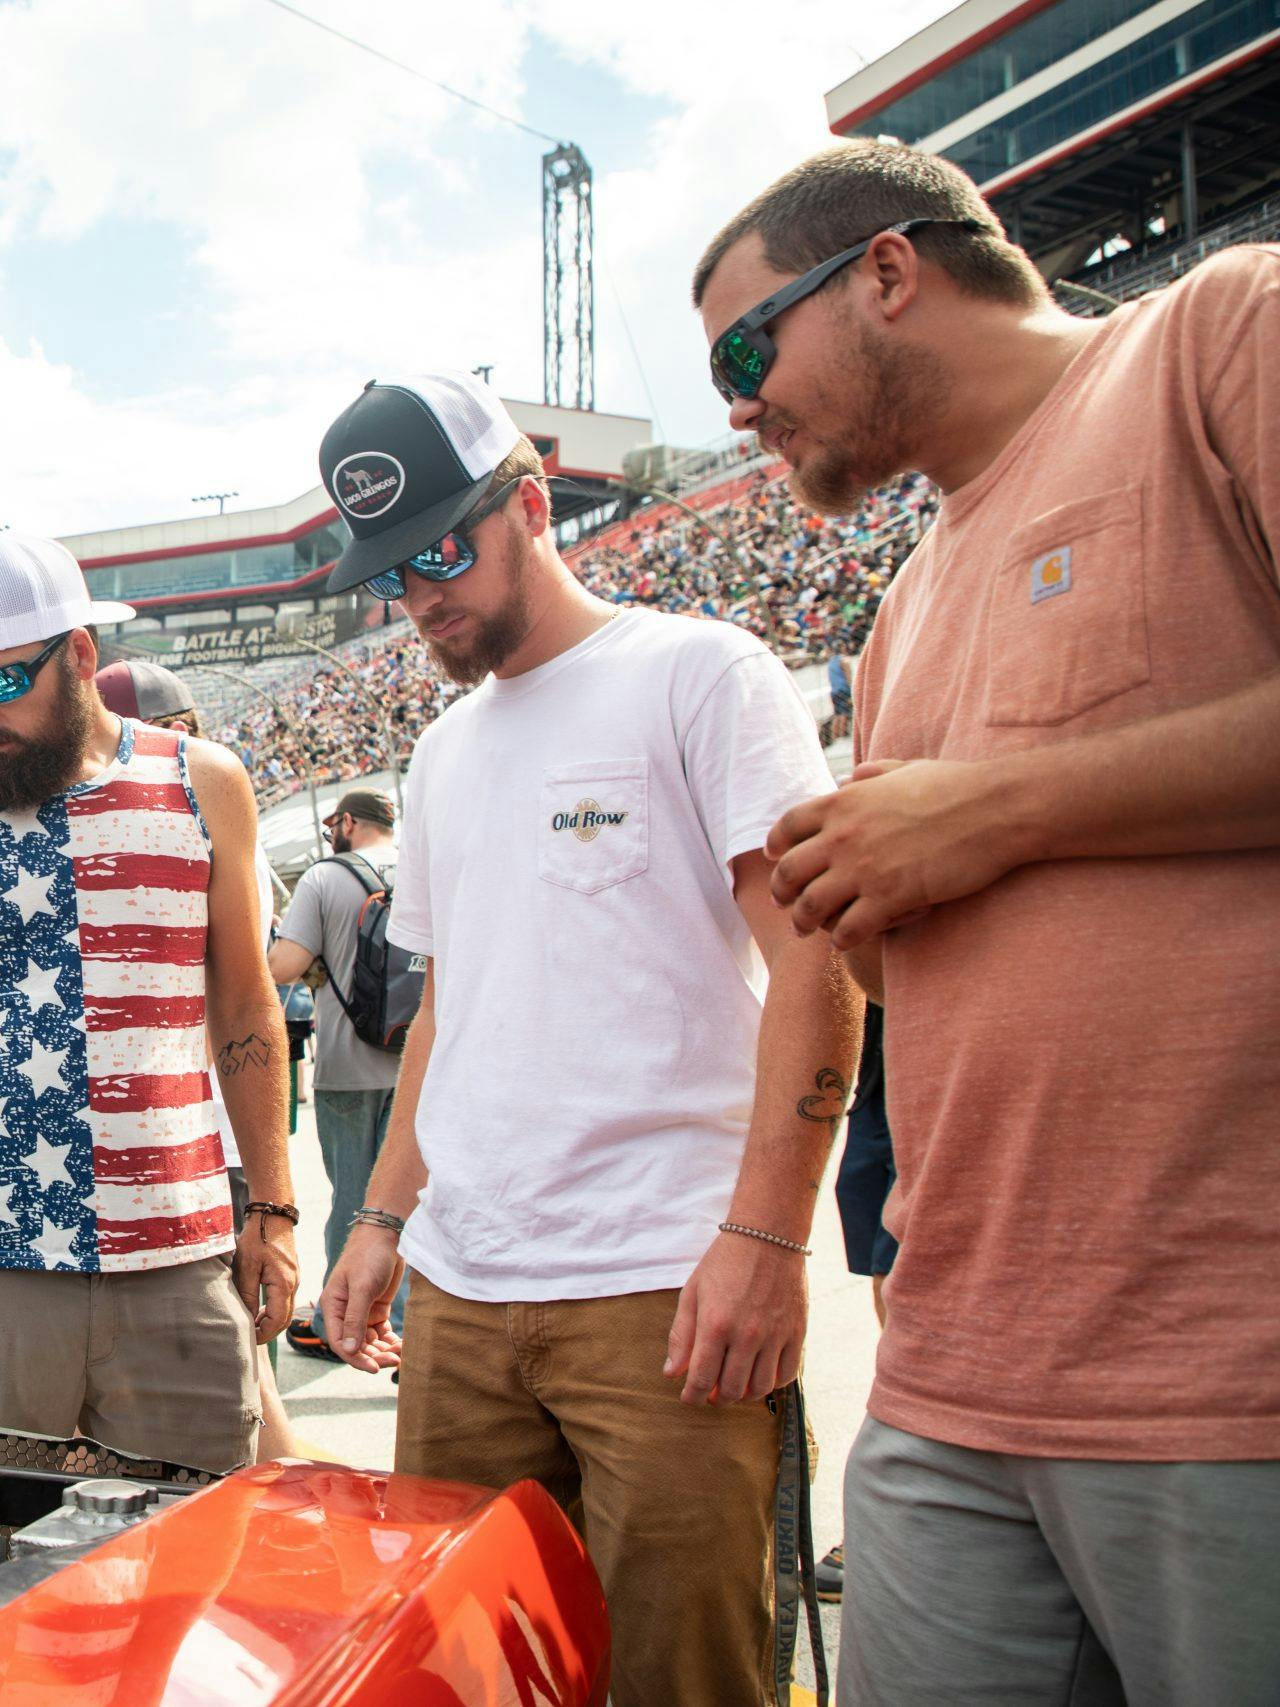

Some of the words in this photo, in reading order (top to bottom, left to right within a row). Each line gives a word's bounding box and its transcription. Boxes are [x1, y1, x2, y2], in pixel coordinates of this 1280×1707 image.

[173, 628, 243, 651] BATTLE
[245, 626, 272, 643] AT
[186, 645, 258, 664] FOOTBALL'S
[553, 813, 579, 830] Old
[582, 811, 627, 828] Row
